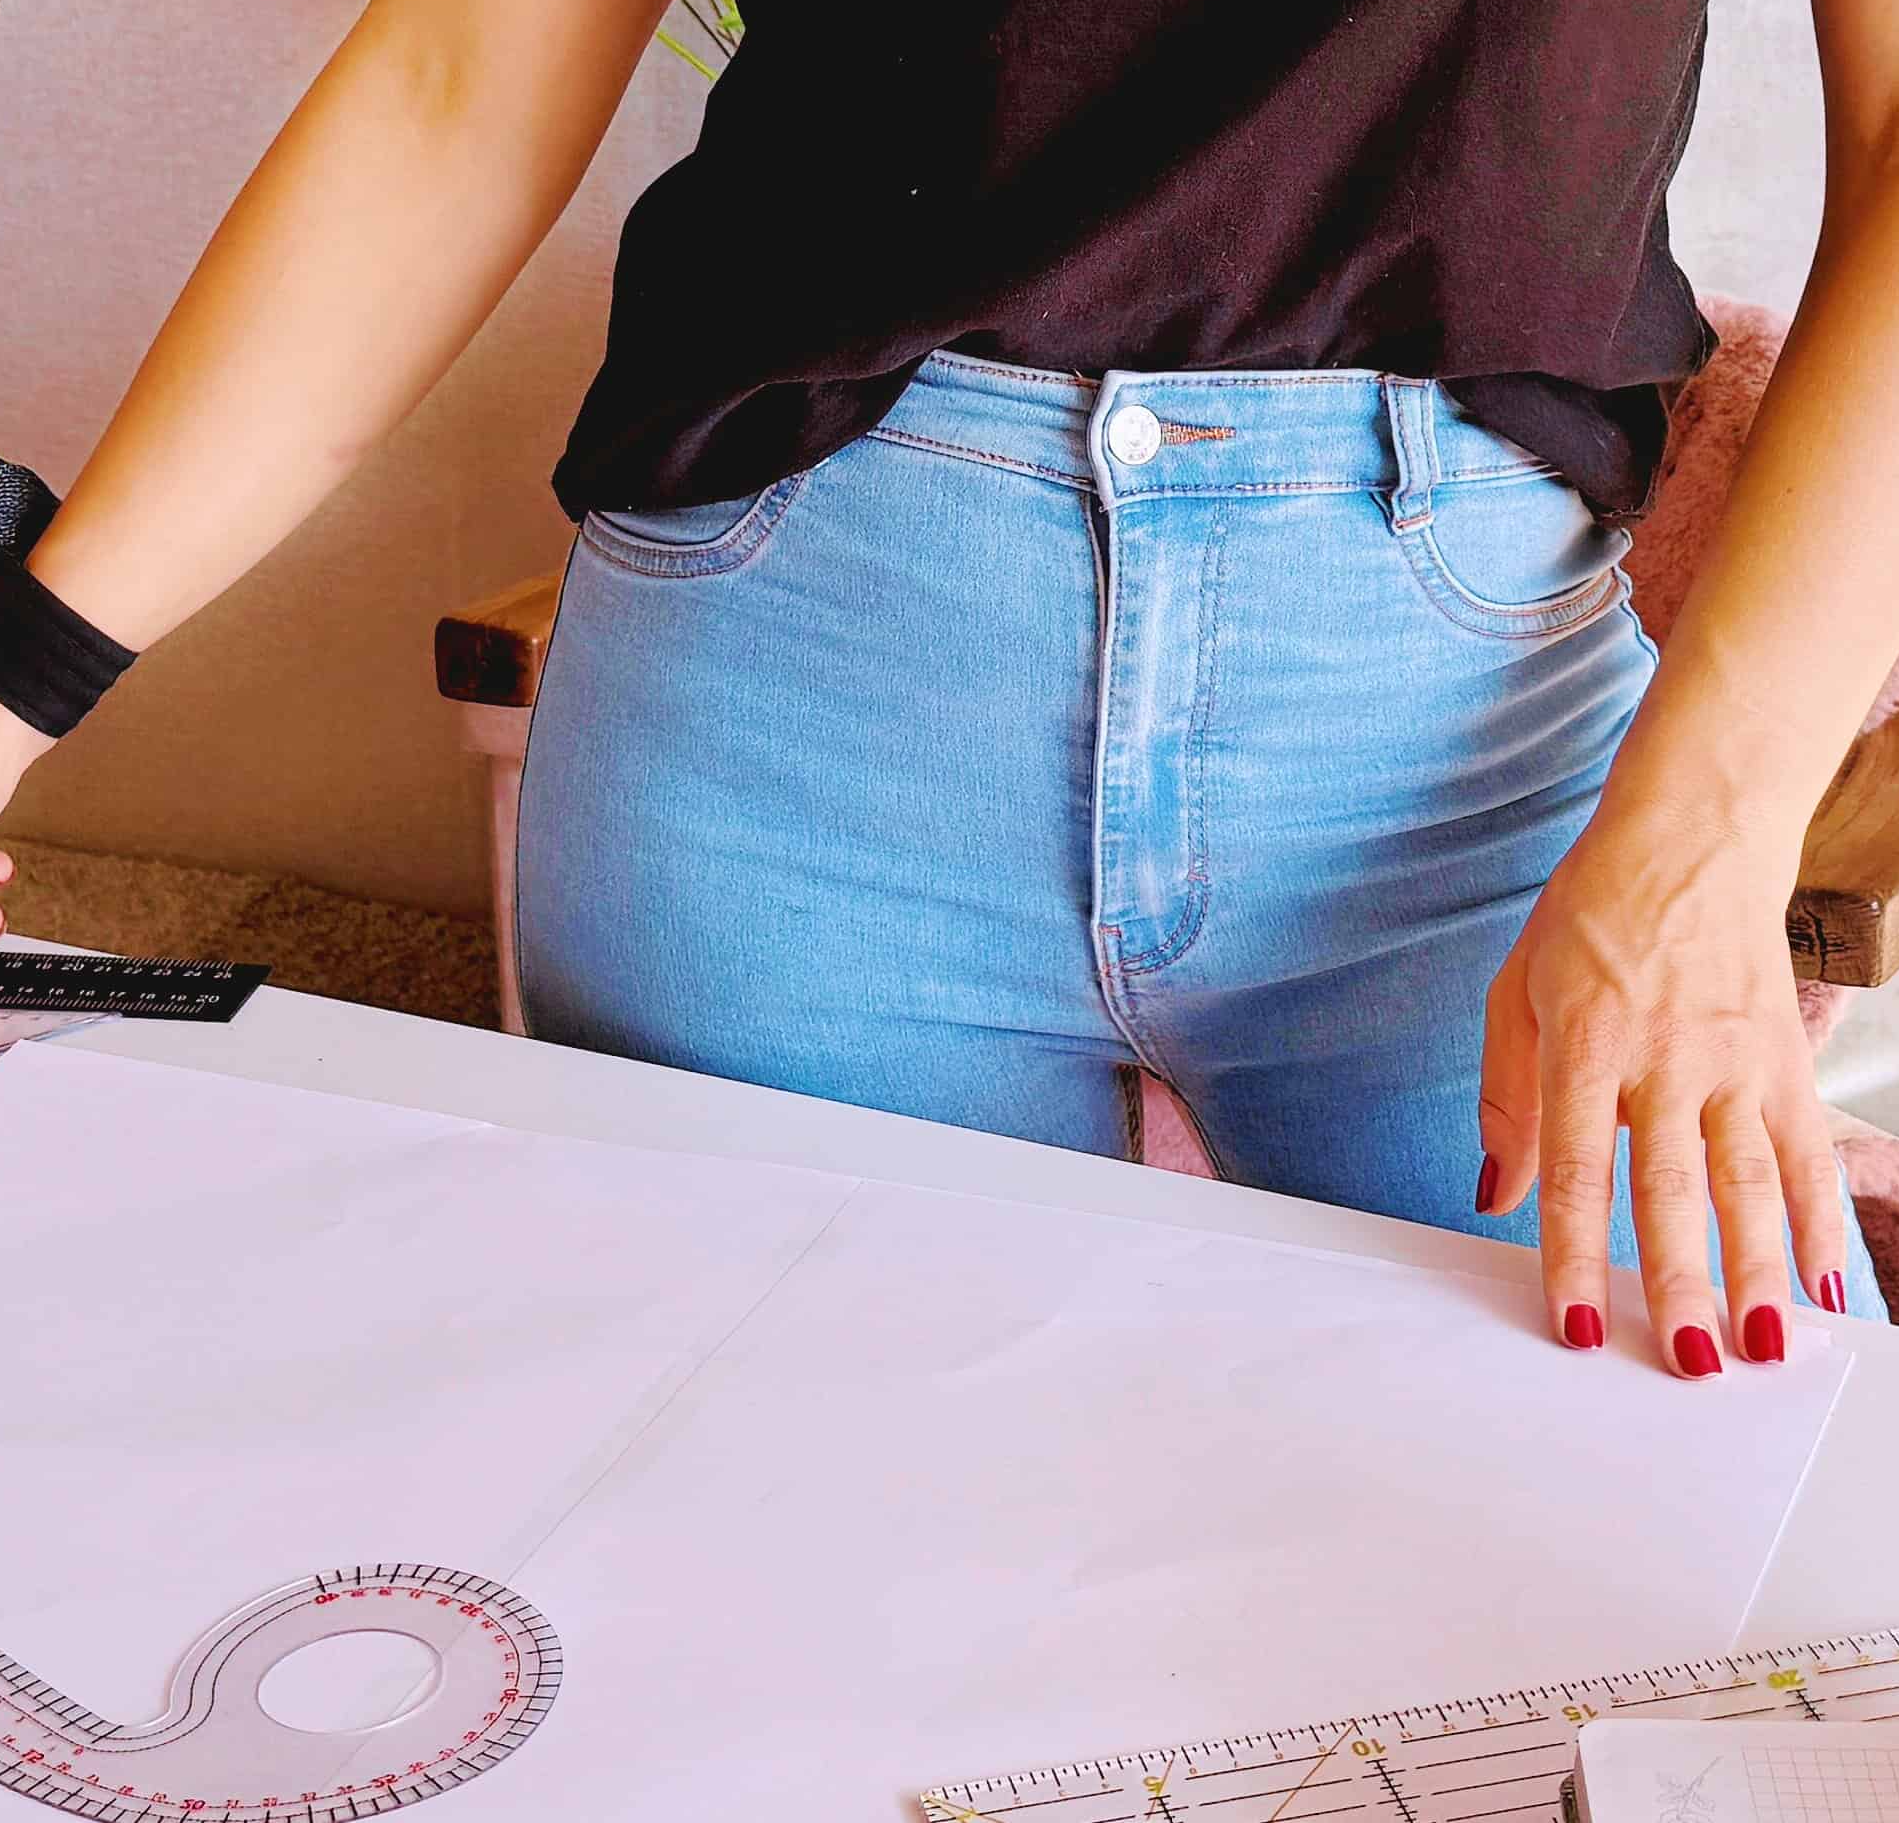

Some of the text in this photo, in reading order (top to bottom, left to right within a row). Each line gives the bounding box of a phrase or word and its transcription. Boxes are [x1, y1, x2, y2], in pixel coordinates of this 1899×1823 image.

[61, 964, 85, 973] 20
[196, 994, 220, 1004] 20
[1351, 1739, 1386, 1756] 10
[1562, 1704, 1598, 1721] 15
